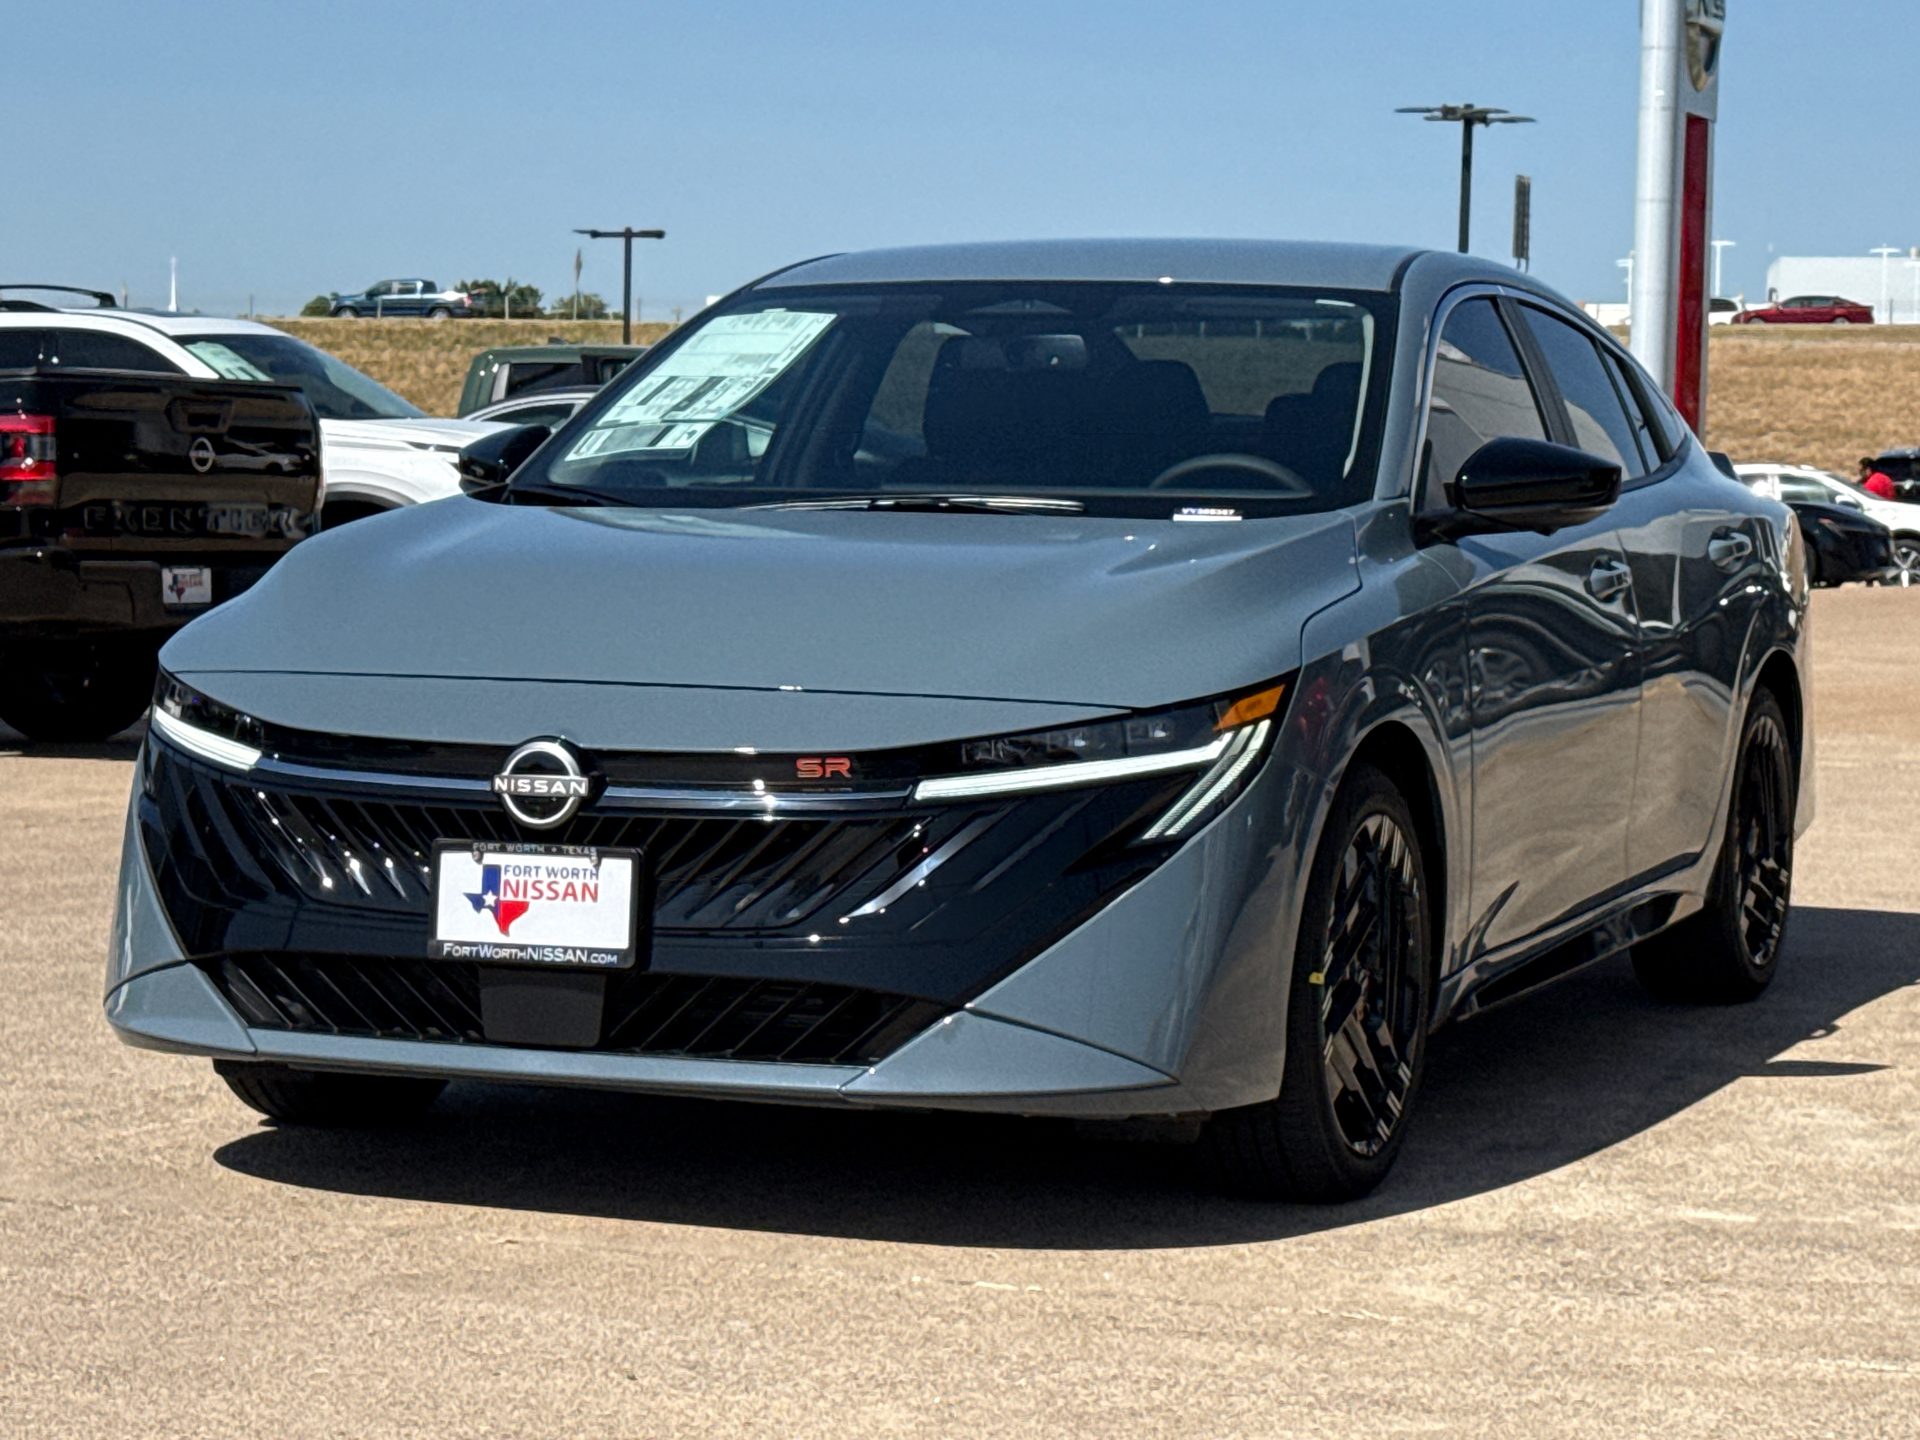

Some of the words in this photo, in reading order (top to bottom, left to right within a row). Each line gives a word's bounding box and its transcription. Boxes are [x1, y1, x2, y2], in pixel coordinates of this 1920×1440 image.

[795, 757, 852, 779] SR
[494, 776, 588, 796] NISSAN
[472, 842, 501, 851] FORT
[506, 844, 545, 853] WORTH
[503, 864, 541, 878] FORT
[545, 865, 599, 881] WORTH
[502, 878, 599, 903] NISSAN
